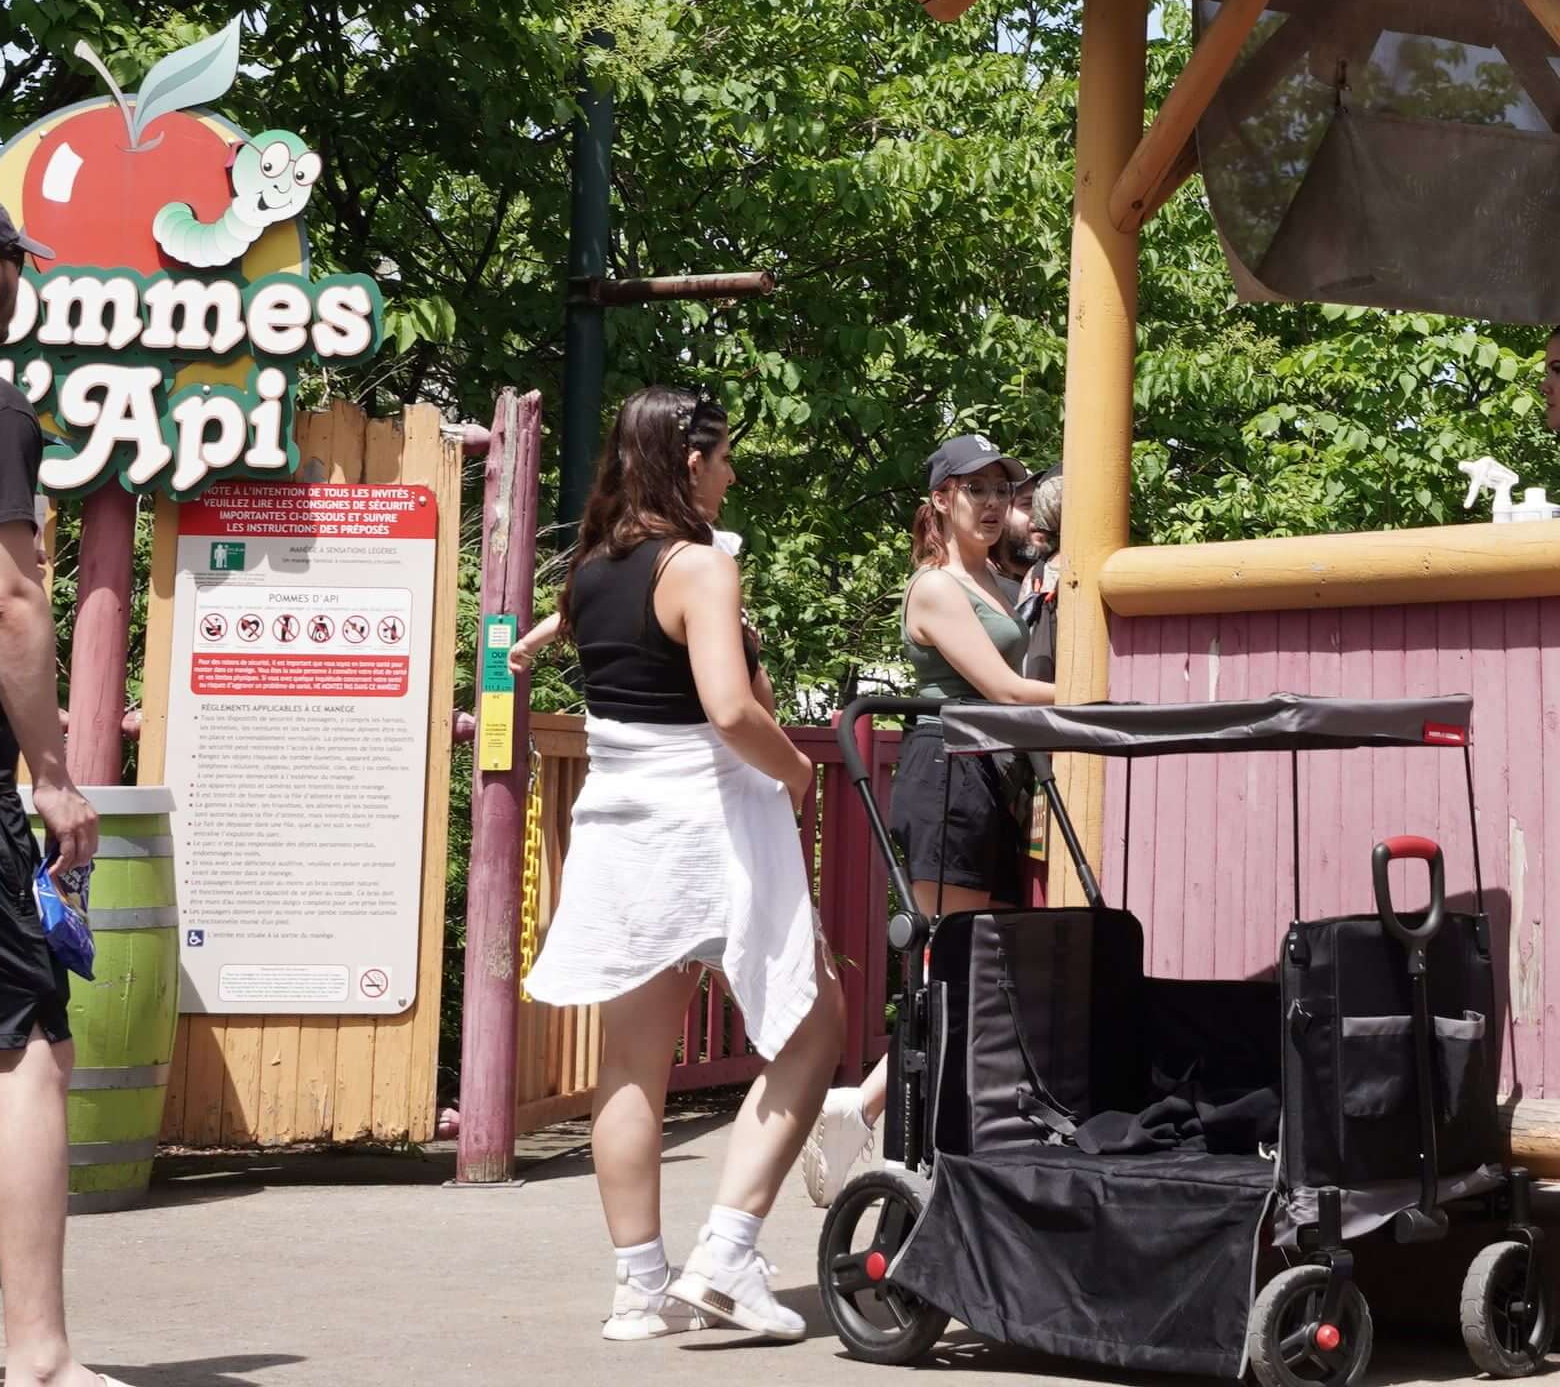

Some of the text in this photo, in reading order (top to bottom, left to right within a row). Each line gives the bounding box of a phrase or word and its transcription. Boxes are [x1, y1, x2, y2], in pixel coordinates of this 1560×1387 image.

[243, 487, 305, 496] L'INTENTION
[307, 487, 322, 497] DE
[322, 488, 349, 497] TOUS
[350, 488, 369, 498] LES
[370, 486, 409, 498] INVITÉS
[204, 498, 415, 510] VEUILLEZ LIRE LES CONSIGNES DE SÉCURITÉ
[219, 510, 398, 522] IMPORTANTES CI-DESSOUS ET SUIVRE
[226, 522, 389, 534] LES INSTRUCTIONS DES PRÉPOSÉS
[268, 593, 340, 605] POMMES D'API
[311, 705, 322, 713] CE
